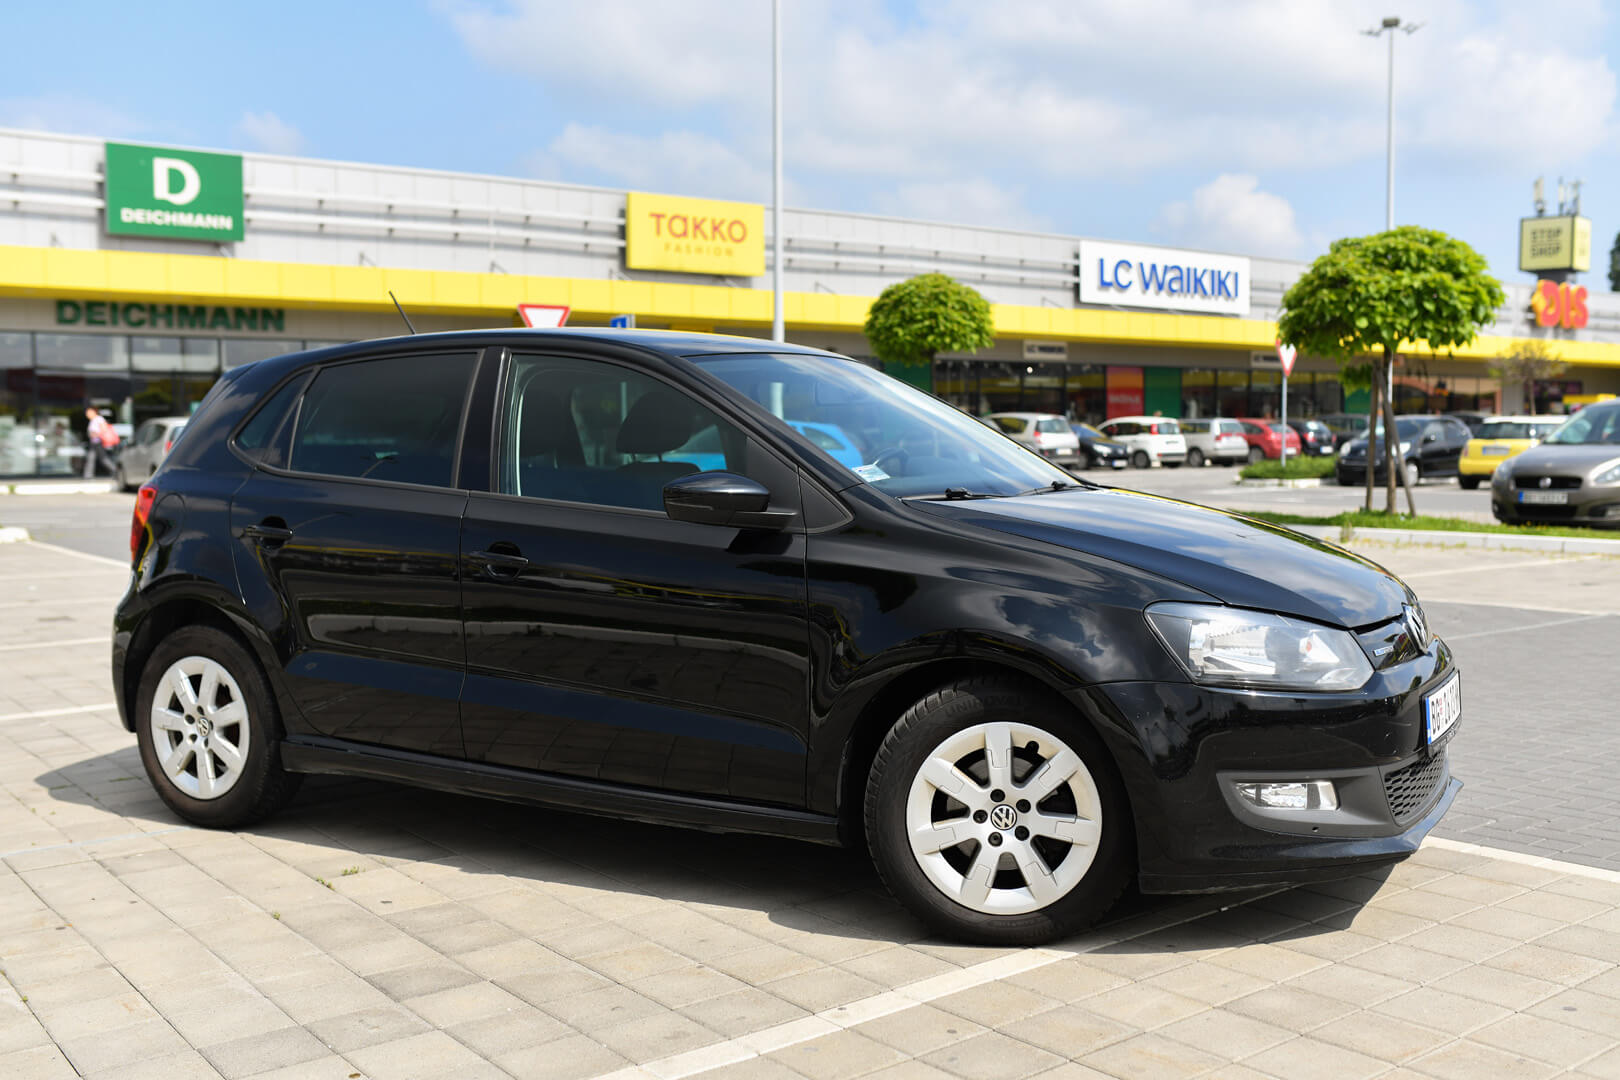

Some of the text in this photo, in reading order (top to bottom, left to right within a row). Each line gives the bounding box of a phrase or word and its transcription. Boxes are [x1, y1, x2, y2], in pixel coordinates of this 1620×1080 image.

[153, 156, 200, 205] D
[120, 207, 233, 231] DEICHMANN
[1531, 228, 1562, 241] STOP
[664, 242, 734, 258] FASHION
[1531, 244, 1561, 258] SHOP
[1100, 257, 1132, 290] LC
[55, 300, 285, 332] DEICHMANN
[1536, 279, 1589, 329] DIS
